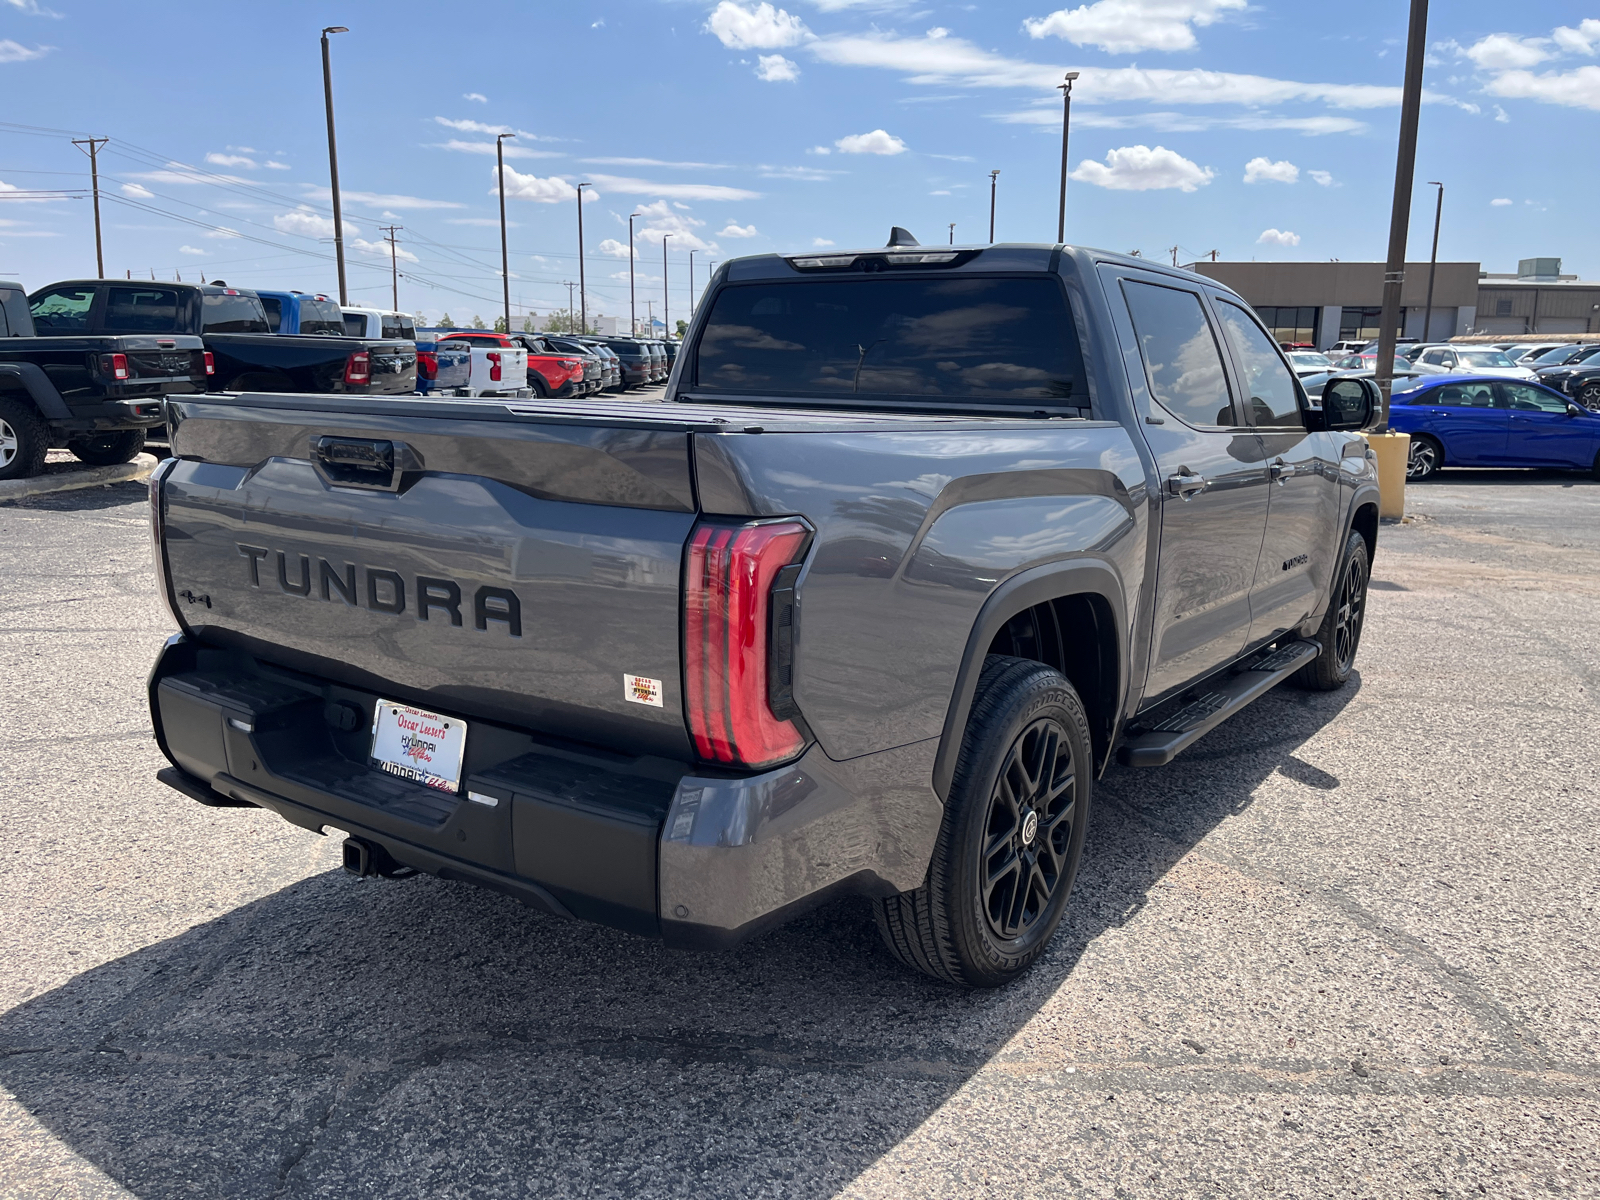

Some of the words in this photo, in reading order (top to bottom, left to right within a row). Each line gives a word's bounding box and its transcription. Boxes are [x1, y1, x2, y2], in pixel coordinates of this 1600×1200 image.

[236, 542, 522, 638] TUNDRA
[633, 688, 657, 696] HYUNDAI
[405, 706, 420, 716] Oscar
[398, 714, 420, 732] Oscar
[420, 721, 446, 740] Leeser's
[401, 735, 437, 753] HYUNDAI
[372, 759, 418, 781] HYUNDAI
[427, 777, 439, 788] El
